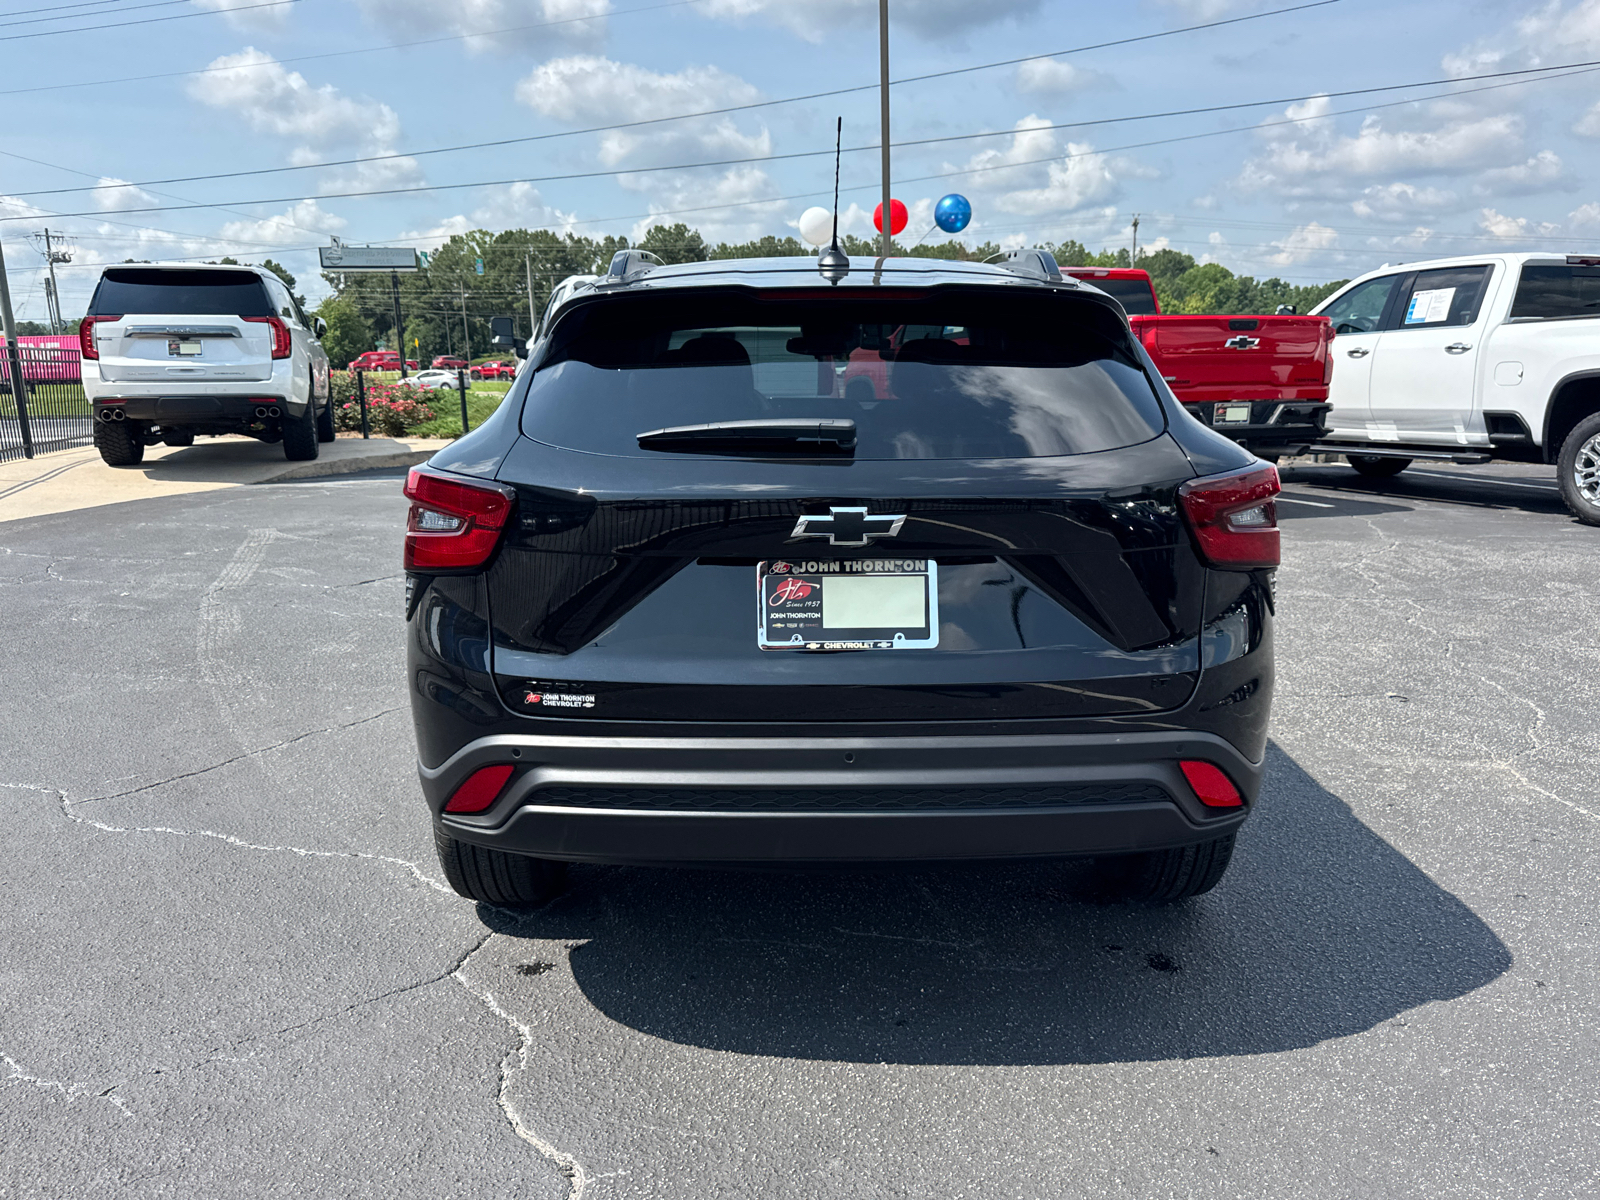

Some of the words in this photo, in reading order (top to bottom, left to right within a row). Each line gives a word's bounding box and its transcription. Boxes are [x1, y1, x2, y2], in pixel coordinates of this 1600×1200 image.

[800, 561, 841, 572] JOHN
[844, 560, 926, 572] THORNTON
[560, 694, 595, 702] THORNTON
